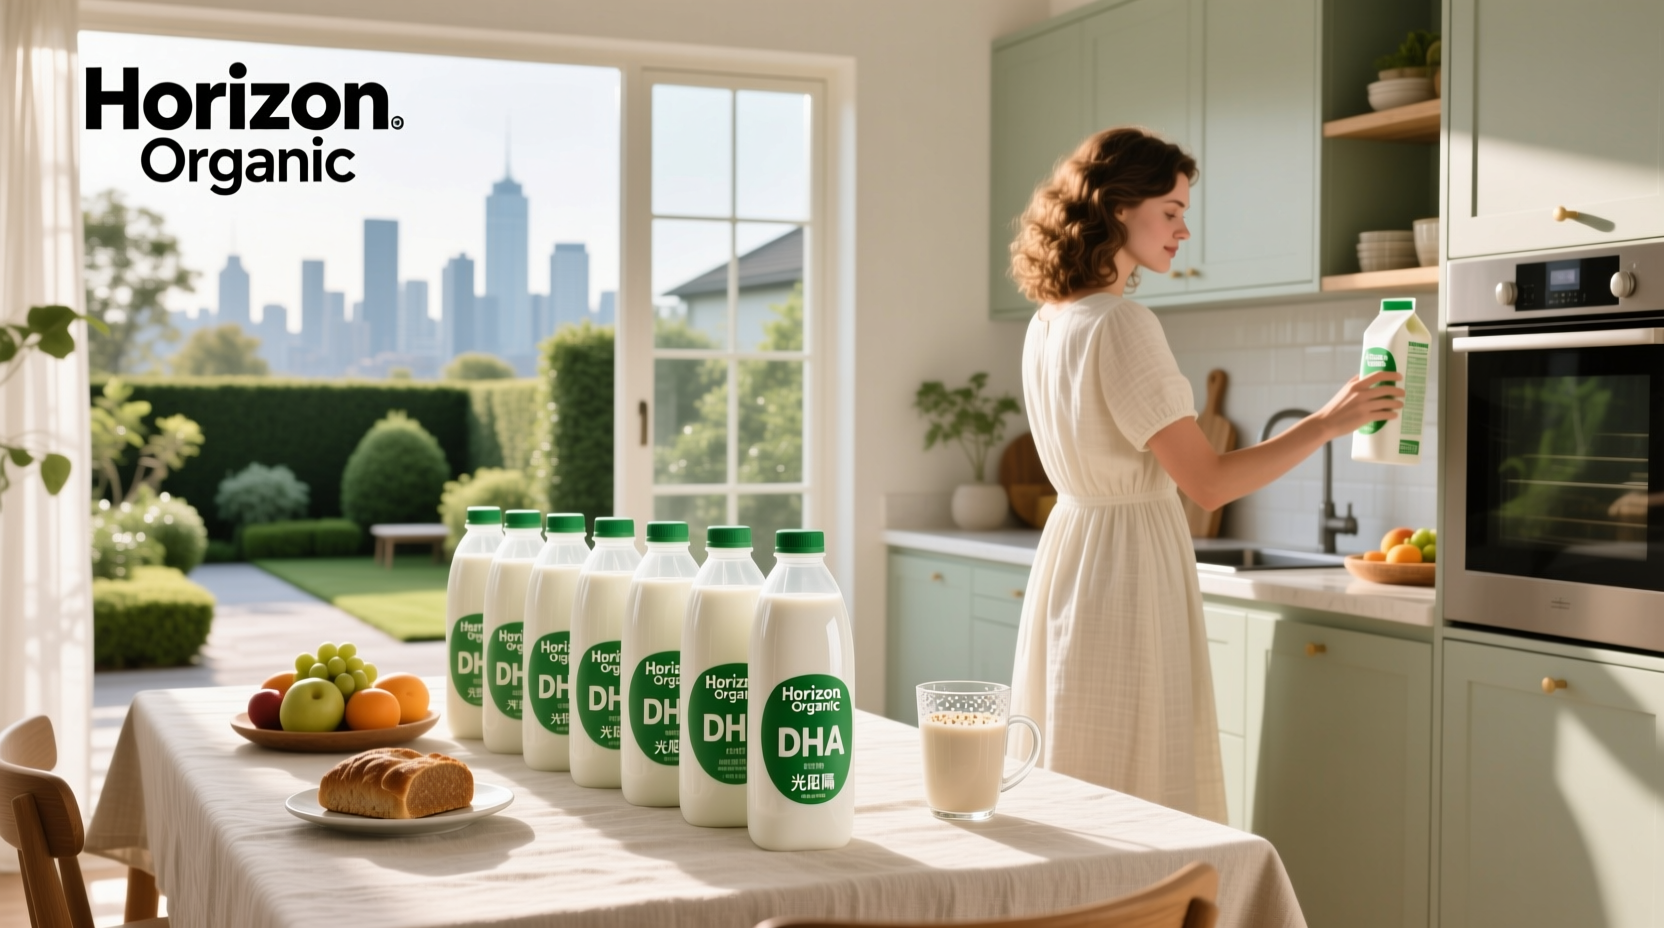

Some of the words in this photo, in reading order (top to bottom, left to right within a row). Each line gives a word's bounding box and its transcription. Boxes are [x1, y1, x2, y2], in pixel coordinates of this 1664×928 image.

[540, 639, 570, 653] Hori
[458, 650, 483, 675] DH
[496, 661, 523, 686] DH
[538, 674, 570, 699] DH
[705, 673, 748, 689] Horiz
[782, 684, 842, 701] Horizon
[588, 685, 621, 711] DH
[791, 701, 841, 715] Organic
[643, 698, 680, 725] DH
[703, 713, 746, 742] DH
[778, 724, 845, 758] DHA
